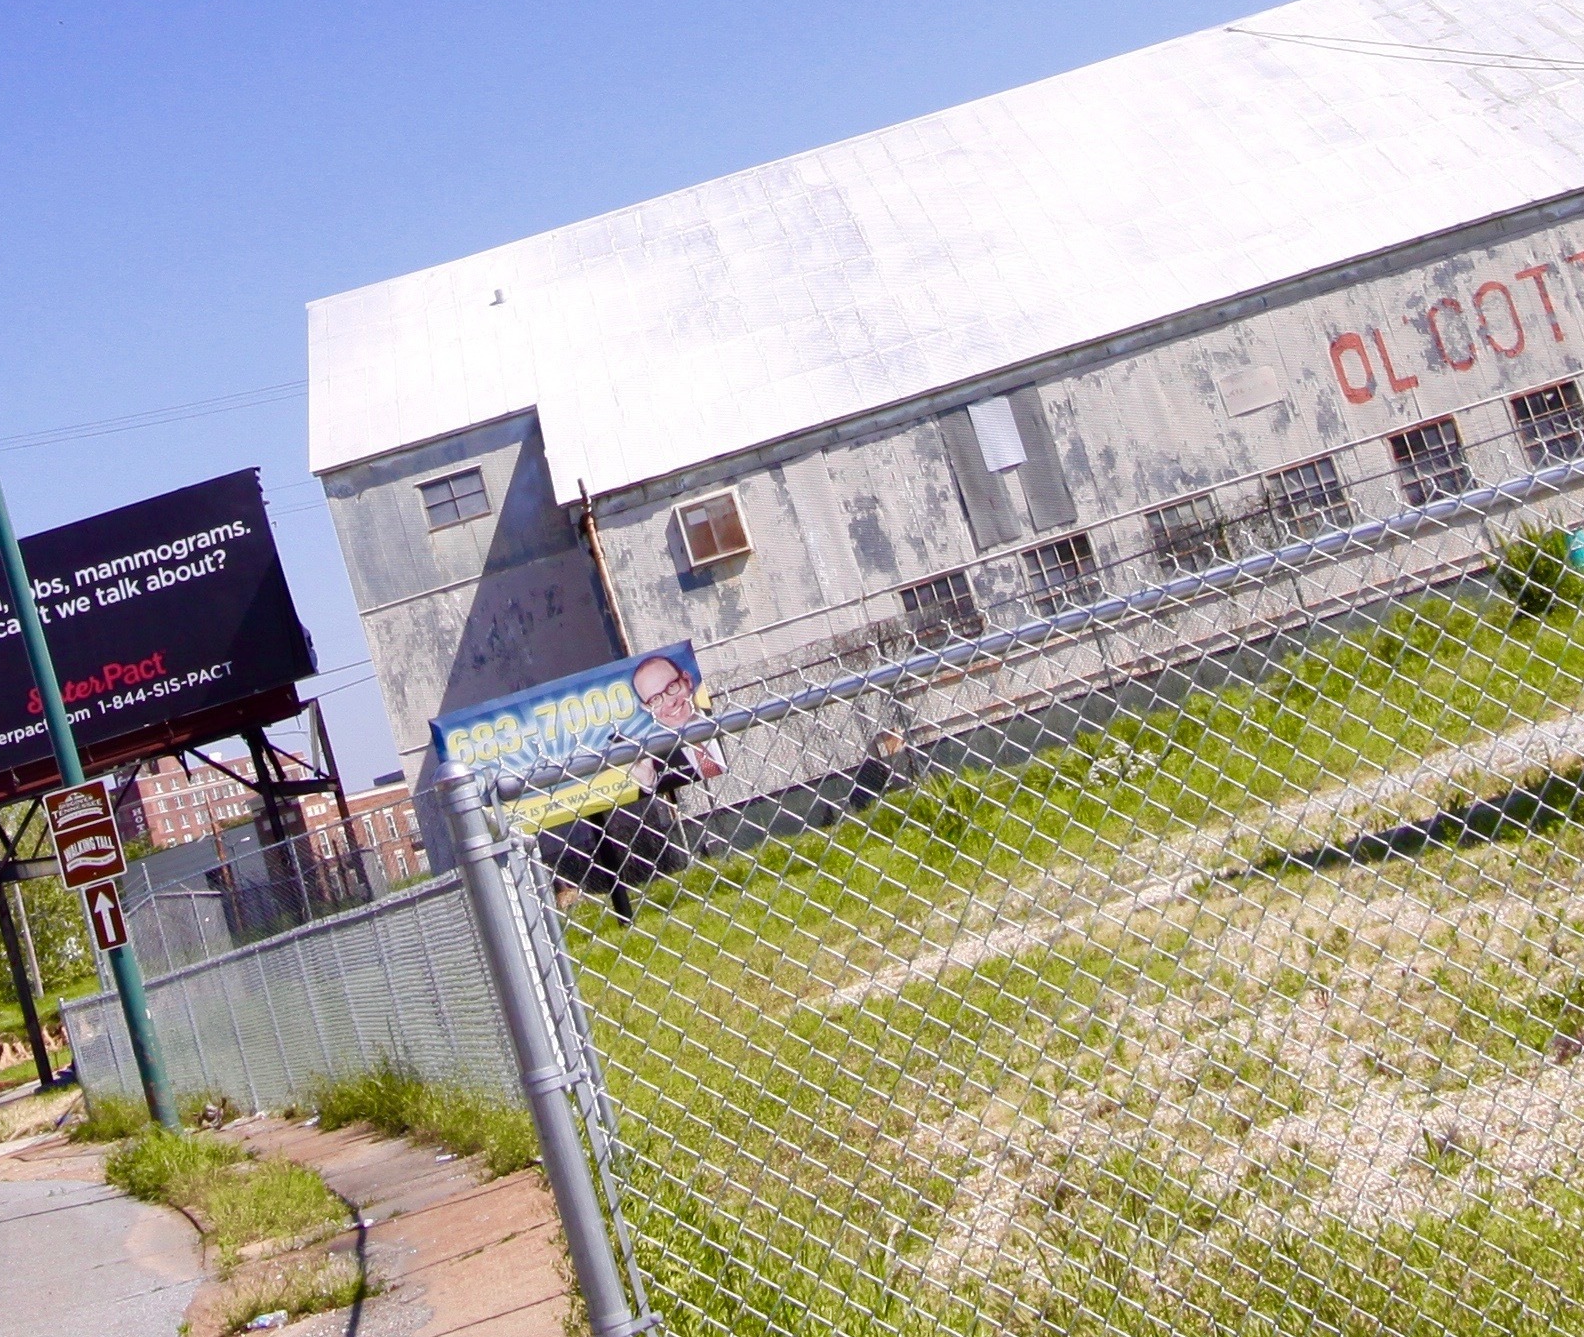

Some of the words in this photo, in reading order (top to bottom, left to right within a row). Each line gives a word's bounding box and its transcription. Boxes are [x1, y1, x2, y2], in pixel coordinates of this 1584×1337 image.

[54, 595, 91, 619] we
[95, 573, 141, 607] talk
[145, 547, 228, 594] about?
[74, 519, 253, 588] mammograms.
[26, 651, 167, 714] SterPact
[96, 660, 233, 714] 1-844-SIS-PACT
[446, 680, 637, 765] 683-7000
